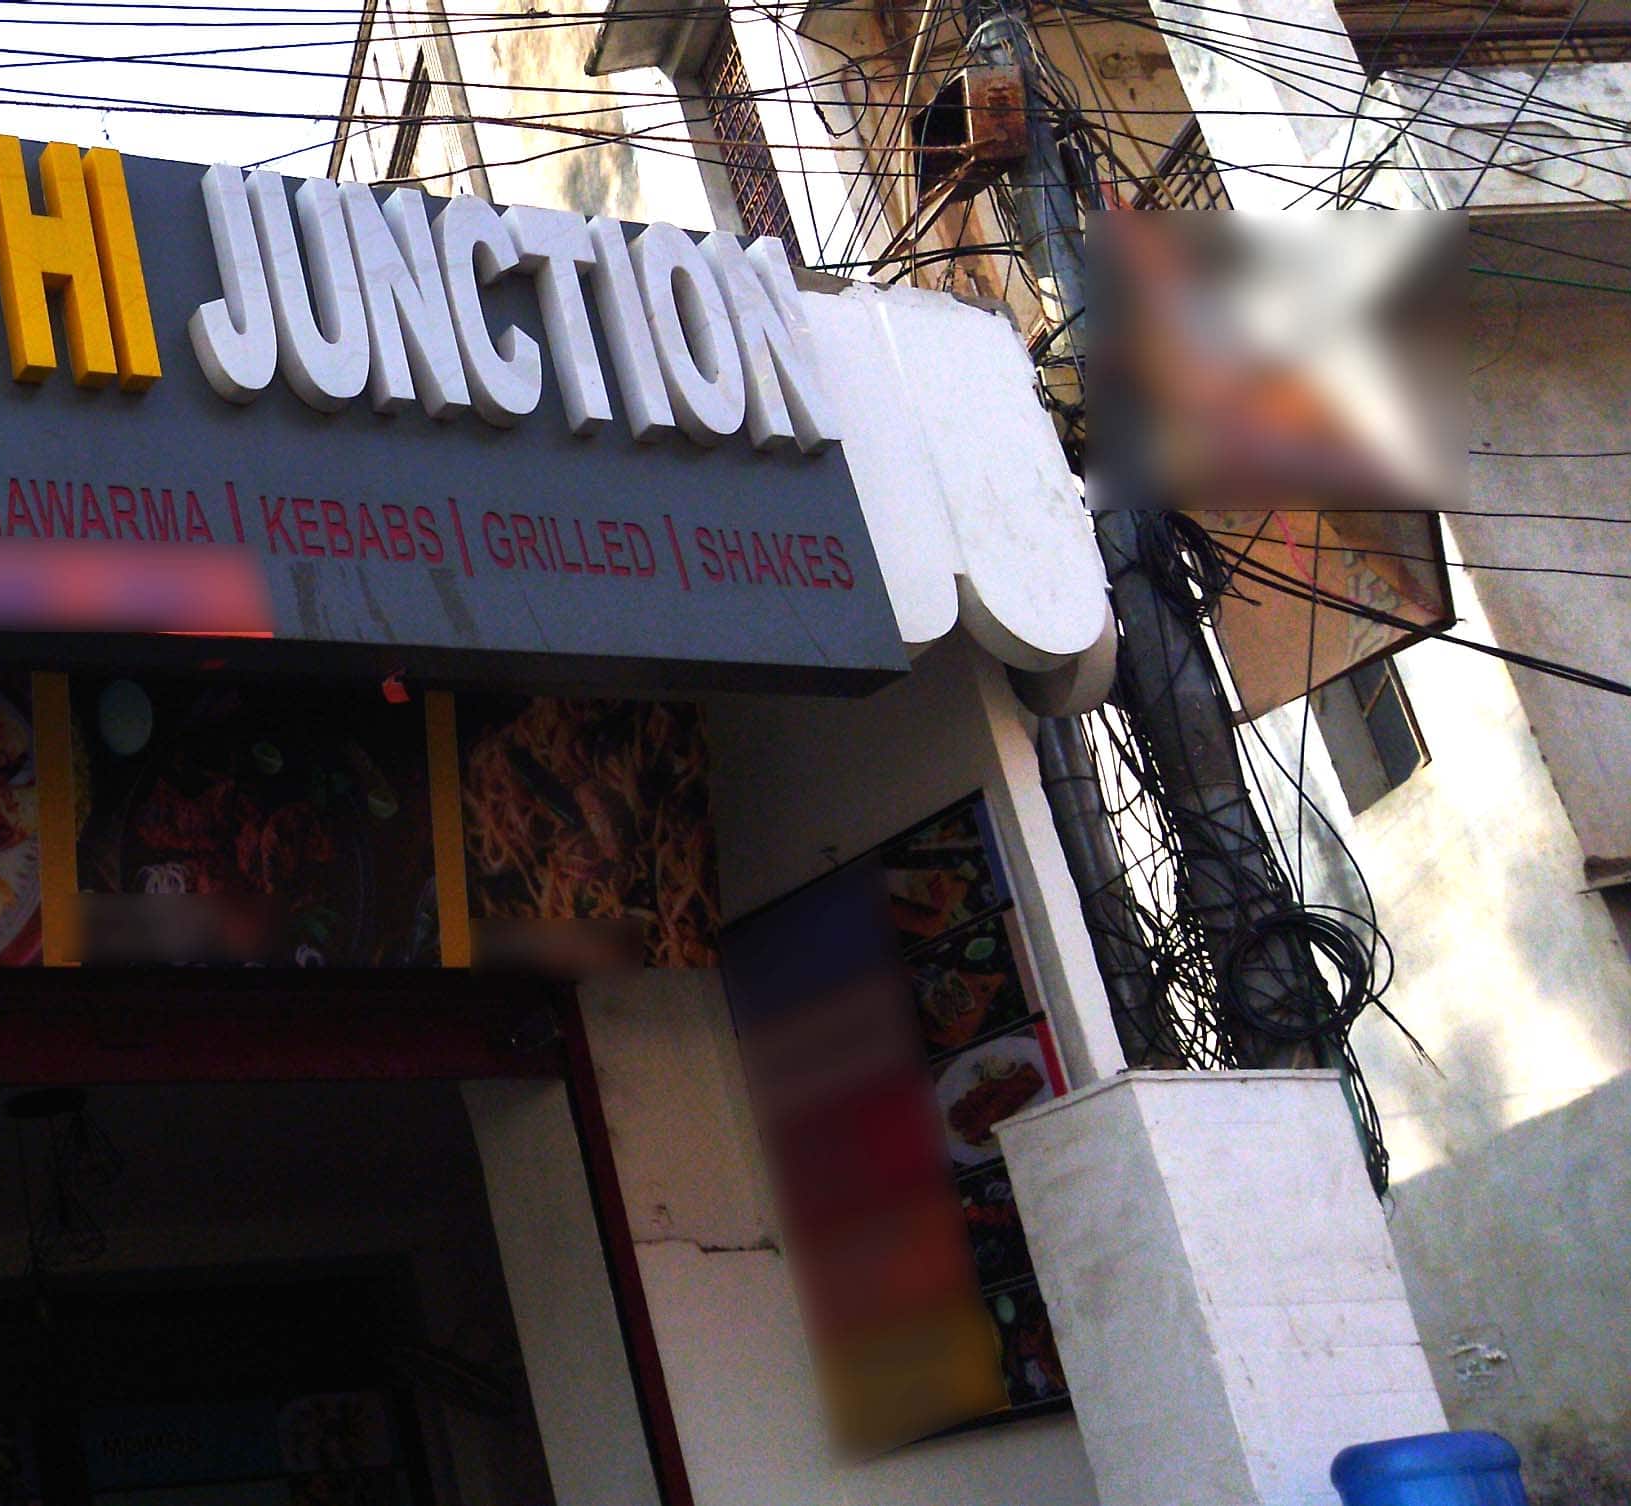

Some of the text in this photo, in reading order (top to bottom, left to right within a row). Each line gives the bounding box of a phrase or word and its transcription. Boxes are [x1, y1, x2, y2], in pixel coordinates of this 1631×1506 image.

[189, 163, 842, 454] JUNCTION
[259, 495, 445, 564] KEBABS
[481, 511, 657, 577] GRILLED
[695, 526, 855, 591] SHAKES
